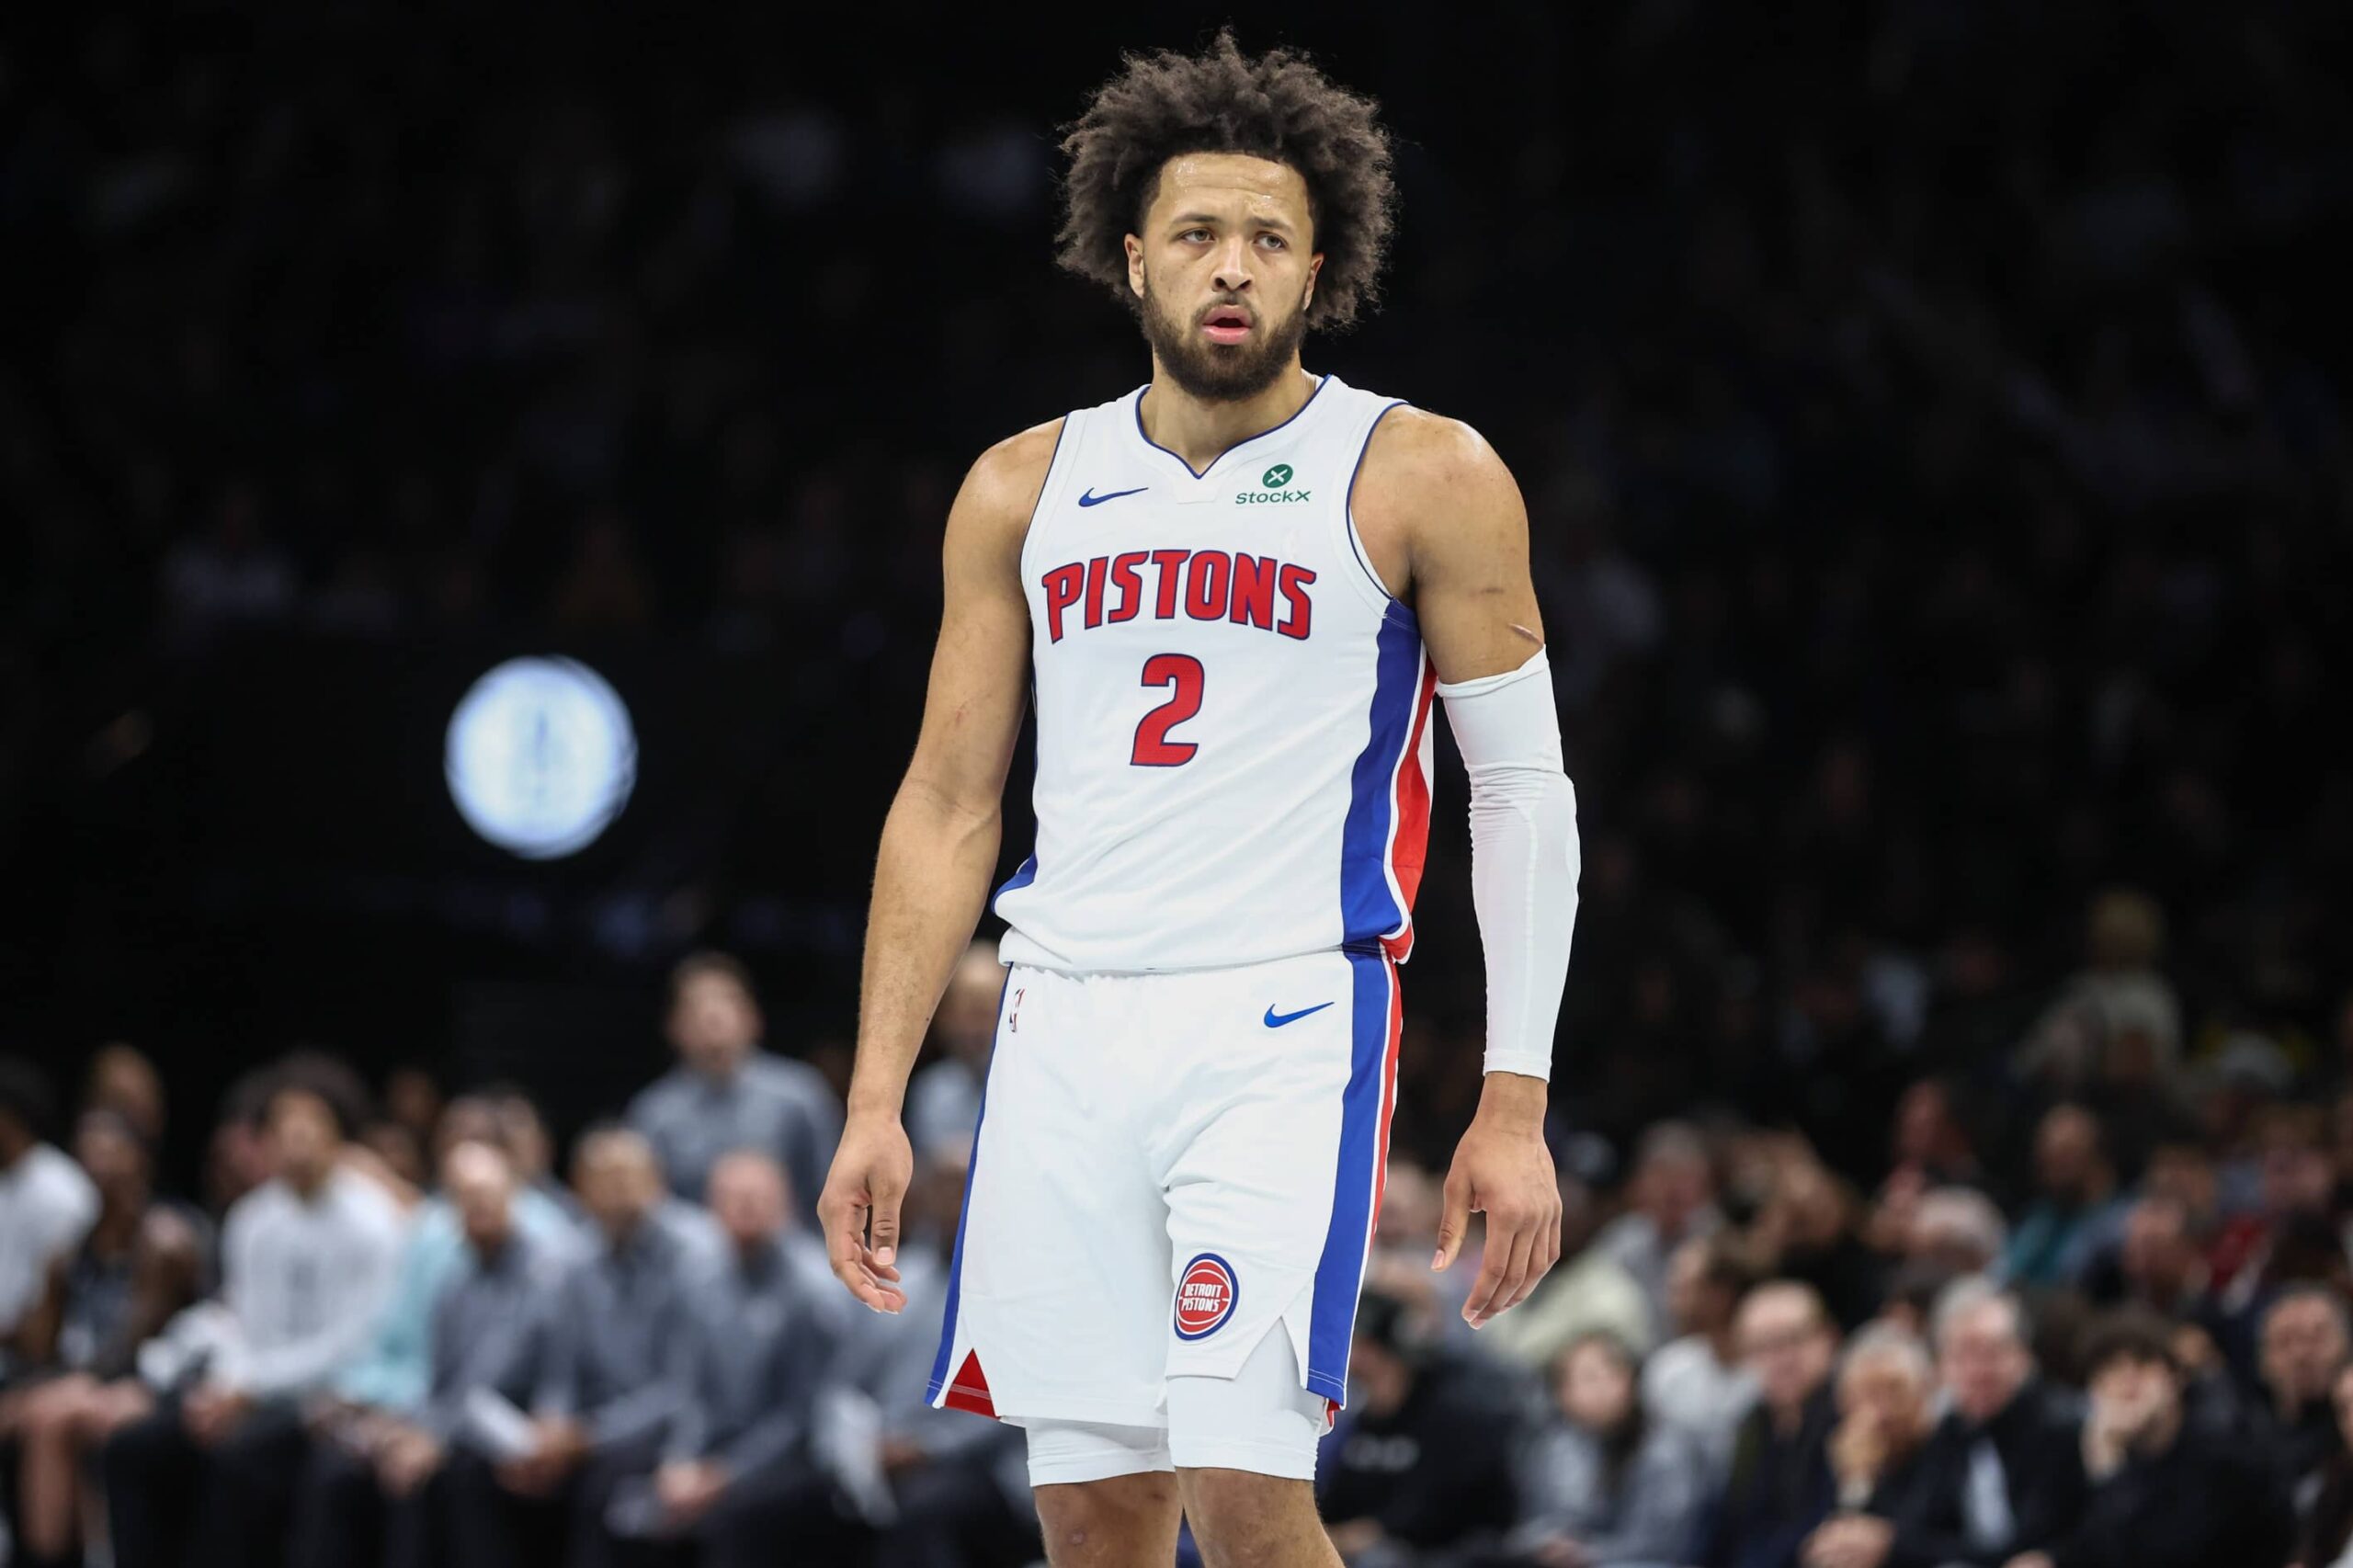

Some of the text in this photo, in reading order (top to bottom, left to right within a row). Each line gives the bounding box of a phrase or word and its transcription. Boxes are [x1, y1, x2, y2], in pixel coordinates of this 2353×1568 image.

[1041, 550, 1316, 644] PISTONS
[1130, 653, 1205, 767] 2
[1181, 1297, 1220, 1312] PISTONS
[1185, 1283, 1223, 1298] DETROIT
